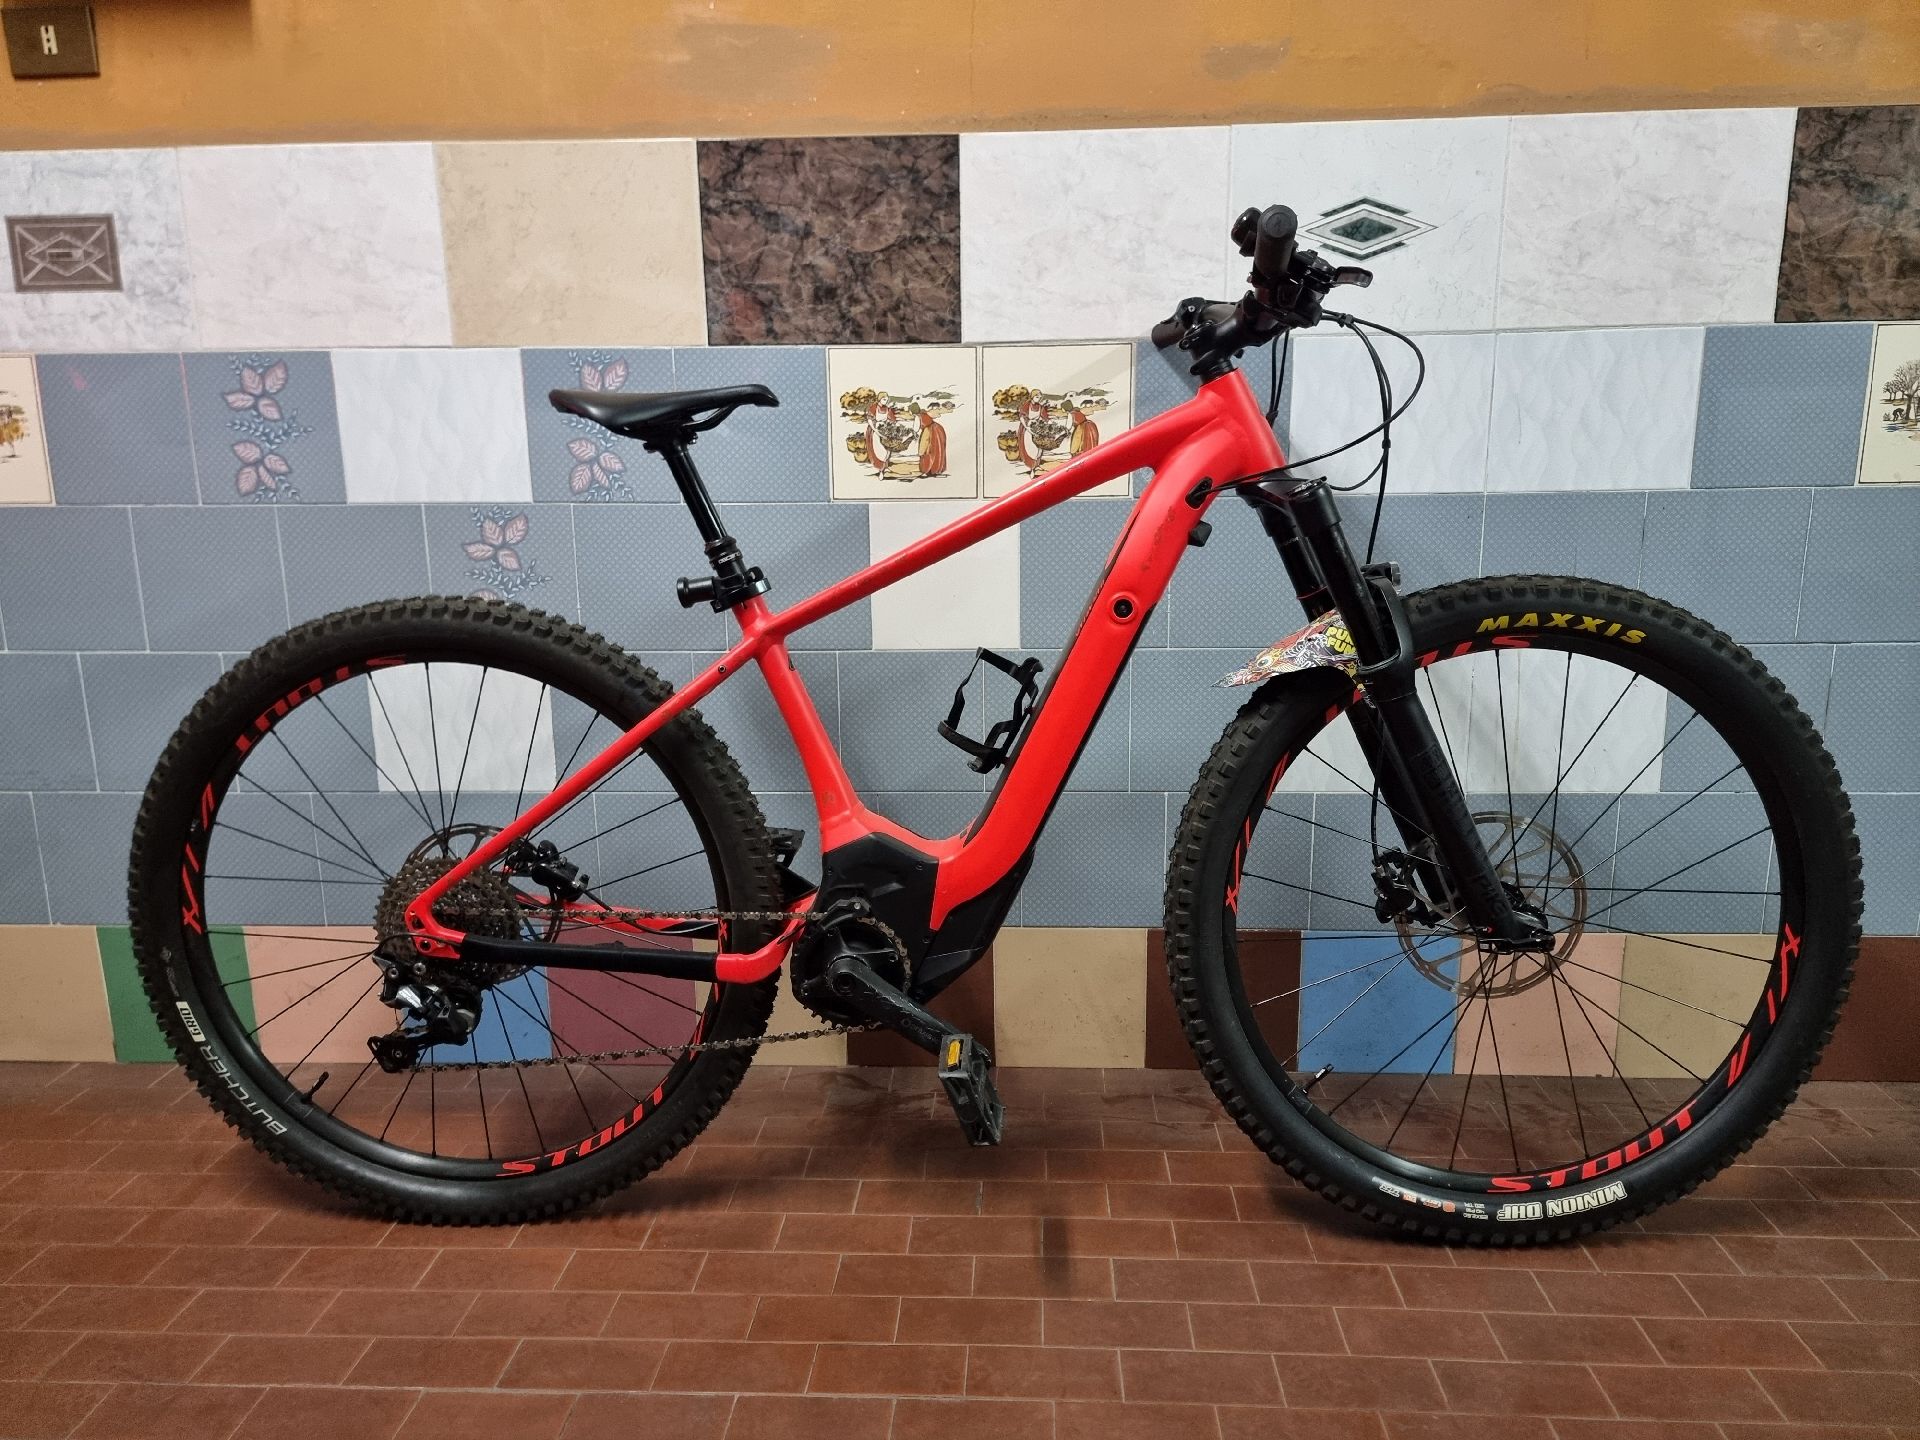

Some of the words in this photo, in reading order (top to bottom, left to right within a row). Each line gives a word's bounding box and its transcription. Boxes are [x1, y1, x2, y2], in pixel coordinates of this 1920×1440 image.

[1475, 612, 1647, 644] MAXXIS
[178, 1006, 203, 1038] GRID
[201, 1044, 287, 1135] BUTCHER
[496, 1076, 668, 1177] STOUT
[1486, 1100, 1697, 1193] STOUT
[1497, 1202, 1543, 1221] DHF
[1546, 1181, 1627, 1217] MINION
